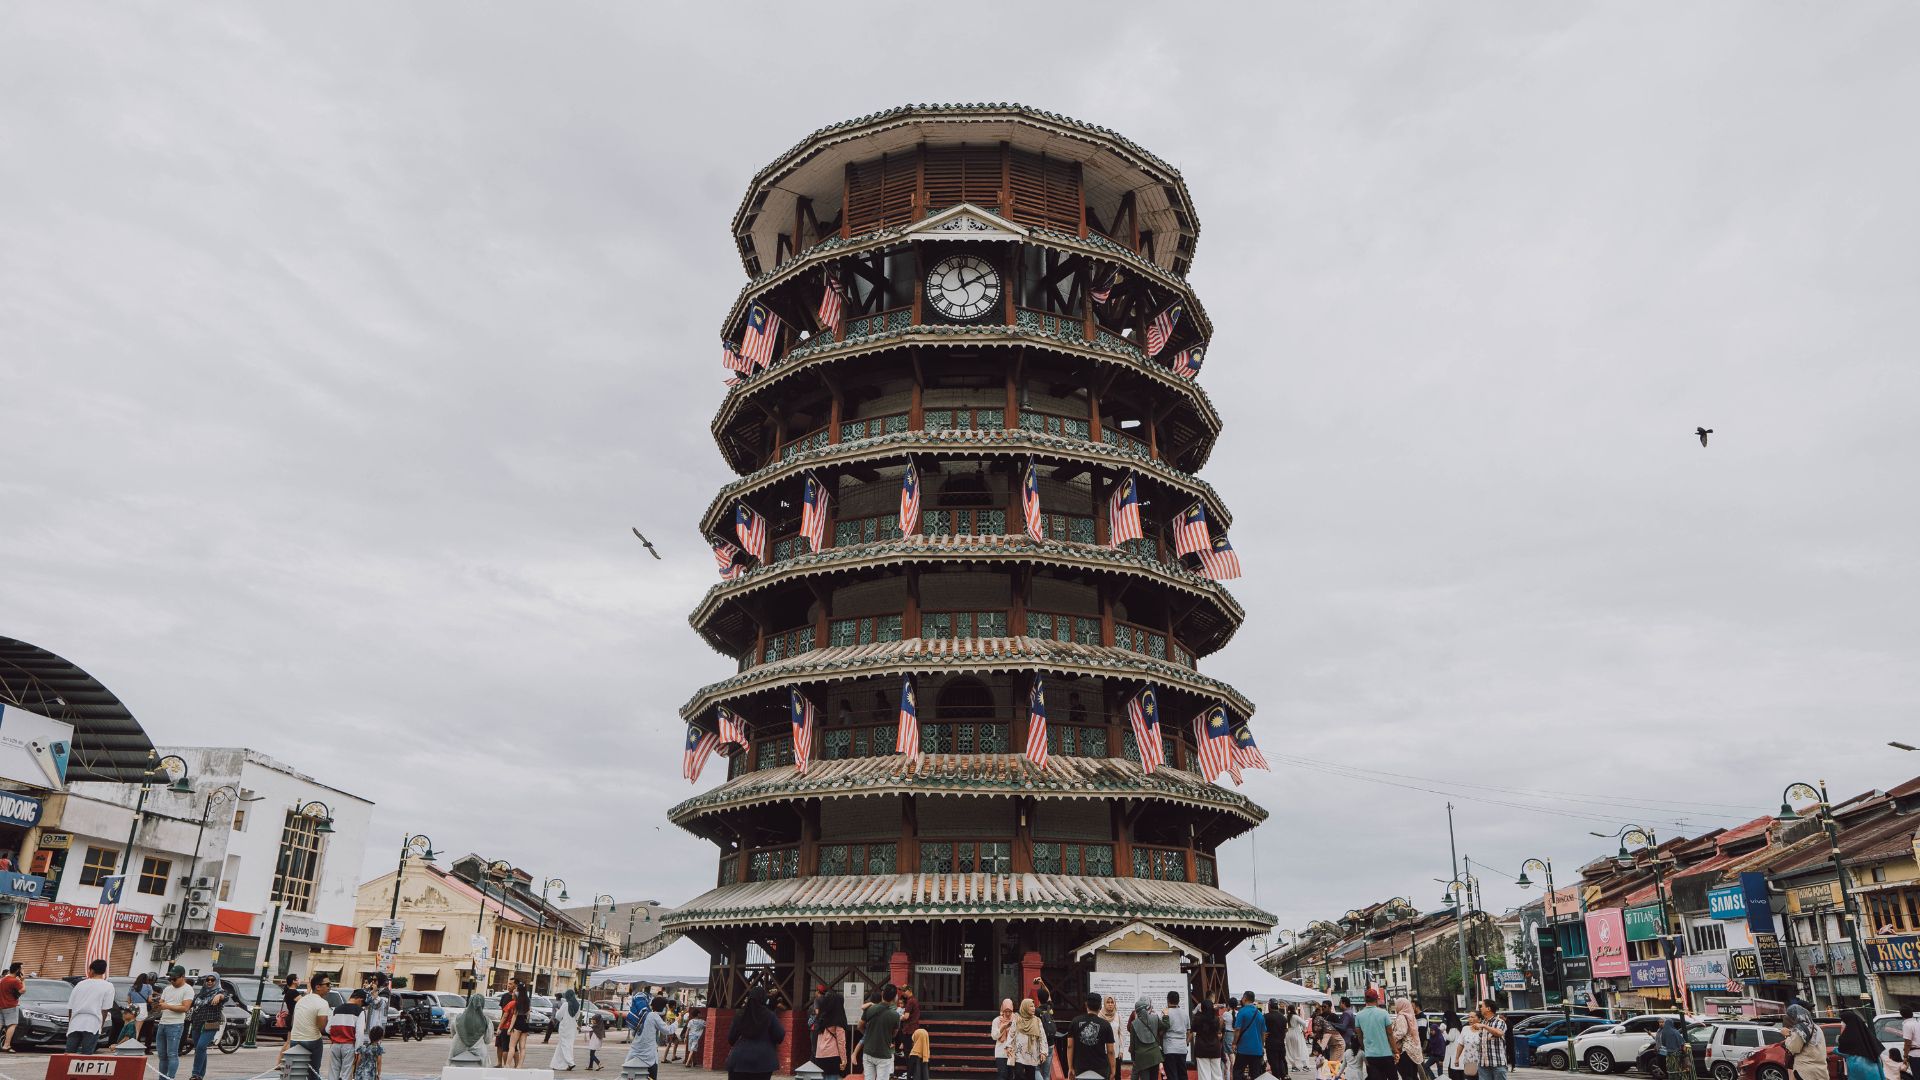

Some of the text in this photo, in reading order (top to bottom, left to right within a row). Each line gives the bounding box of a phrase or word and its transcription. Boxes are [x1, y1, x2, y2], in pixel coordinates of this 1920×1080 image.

[75, 907, 97, 918] SHAN
[1633, 910, 1654, 924] TITAN
[1735, 955, 1755, 970] ONE
[74, 1062, 110, 1073] MPTI
